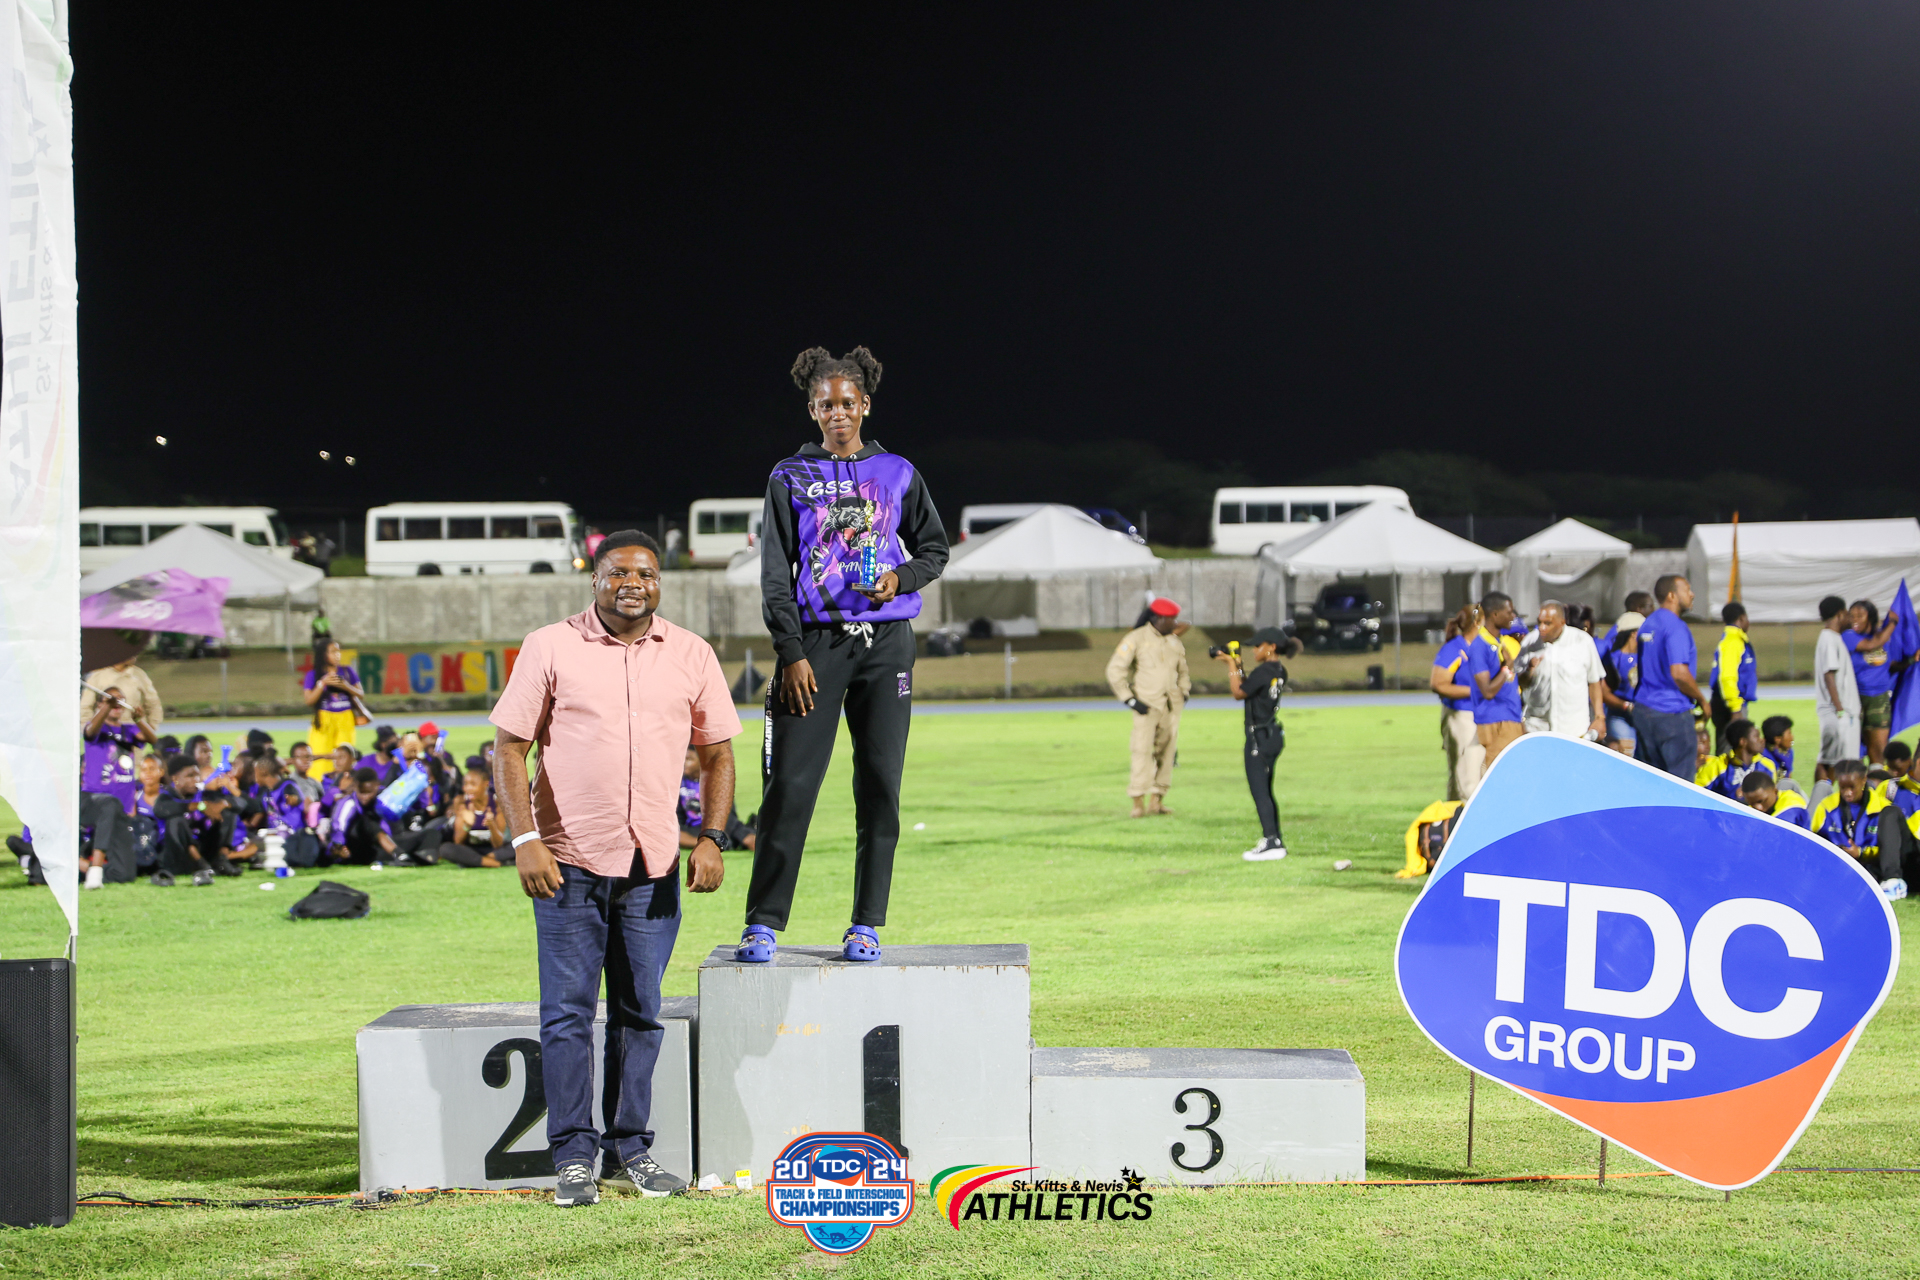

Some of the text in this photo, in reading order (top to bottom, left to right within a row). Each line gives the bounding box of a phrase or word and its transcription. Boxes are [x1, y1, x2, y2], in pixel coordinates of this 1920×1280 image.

[807, 480, 854, 498] GSS
[837, 561, 892, 573] PANERS
[1463, 872, 1824, 1040] TDC
[863, 1024, 910, 1160] 1
[1484, 1016, 1696, 1084] GROUP
[482, 1037, 560, 1181] 2
[1171, 1087, 1224, 1172] 3
